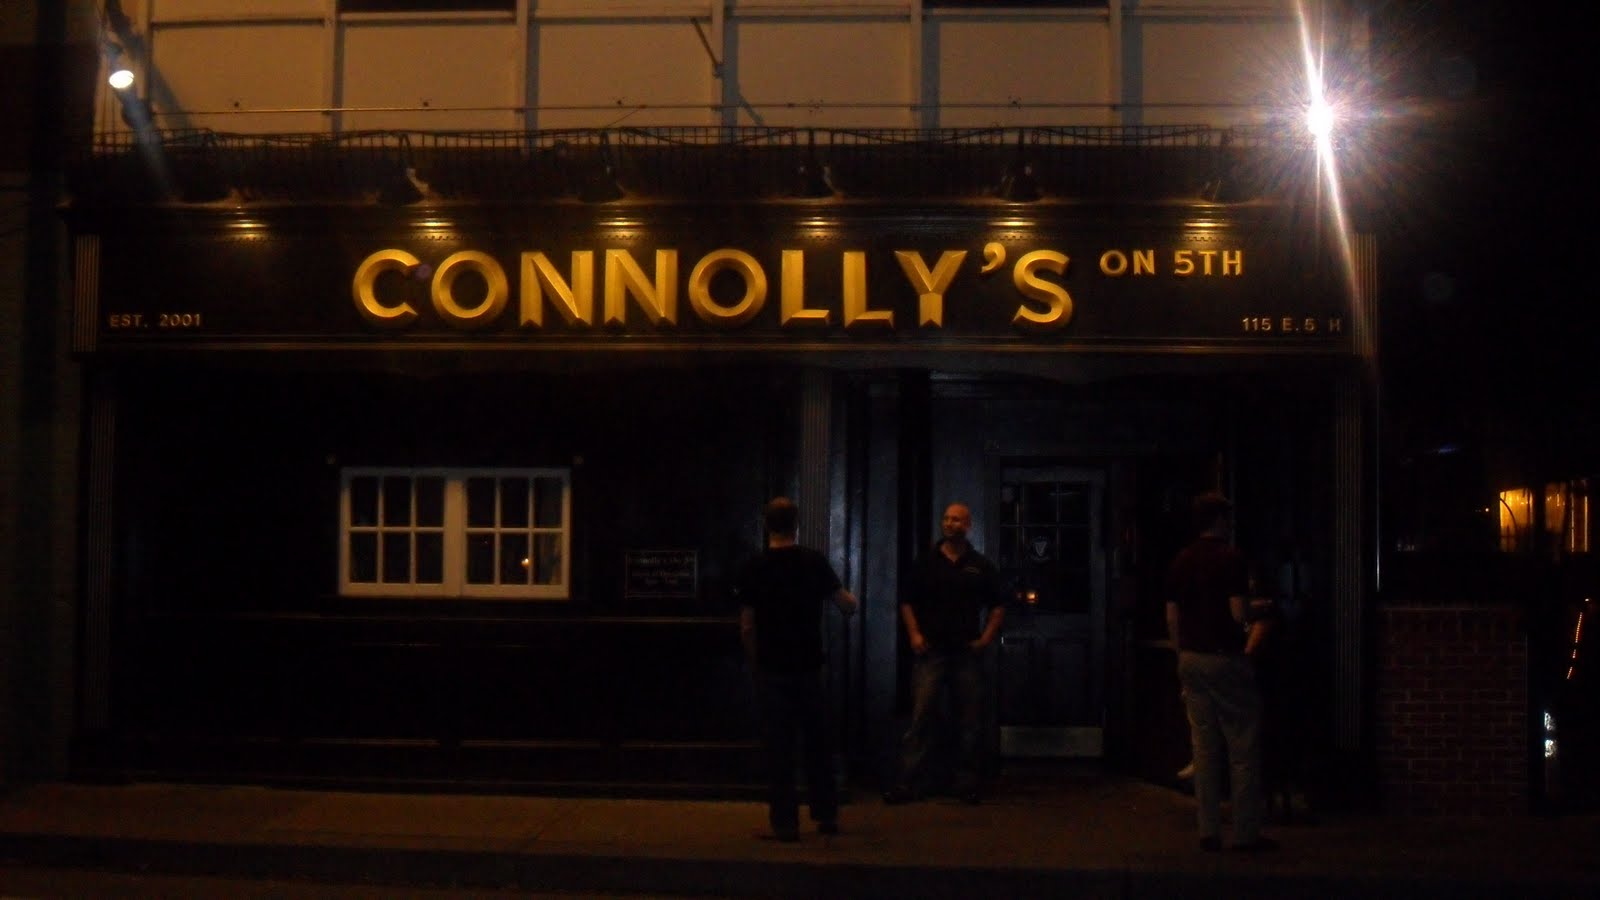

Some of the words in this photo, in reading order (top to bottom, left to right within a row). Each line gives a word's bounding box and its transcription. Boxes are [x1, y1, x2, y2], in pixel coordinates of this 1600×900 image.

[1099, 248, 1156, 277] ON
[1173, 248, 1243, 277] 5TH
[352, 241, 1074, 328] CONNOLLY'S
[109, 313, 148, 329] EST.
[159, 312, 202, 328] 2001
[1241, 316, 1272, 332] 115
